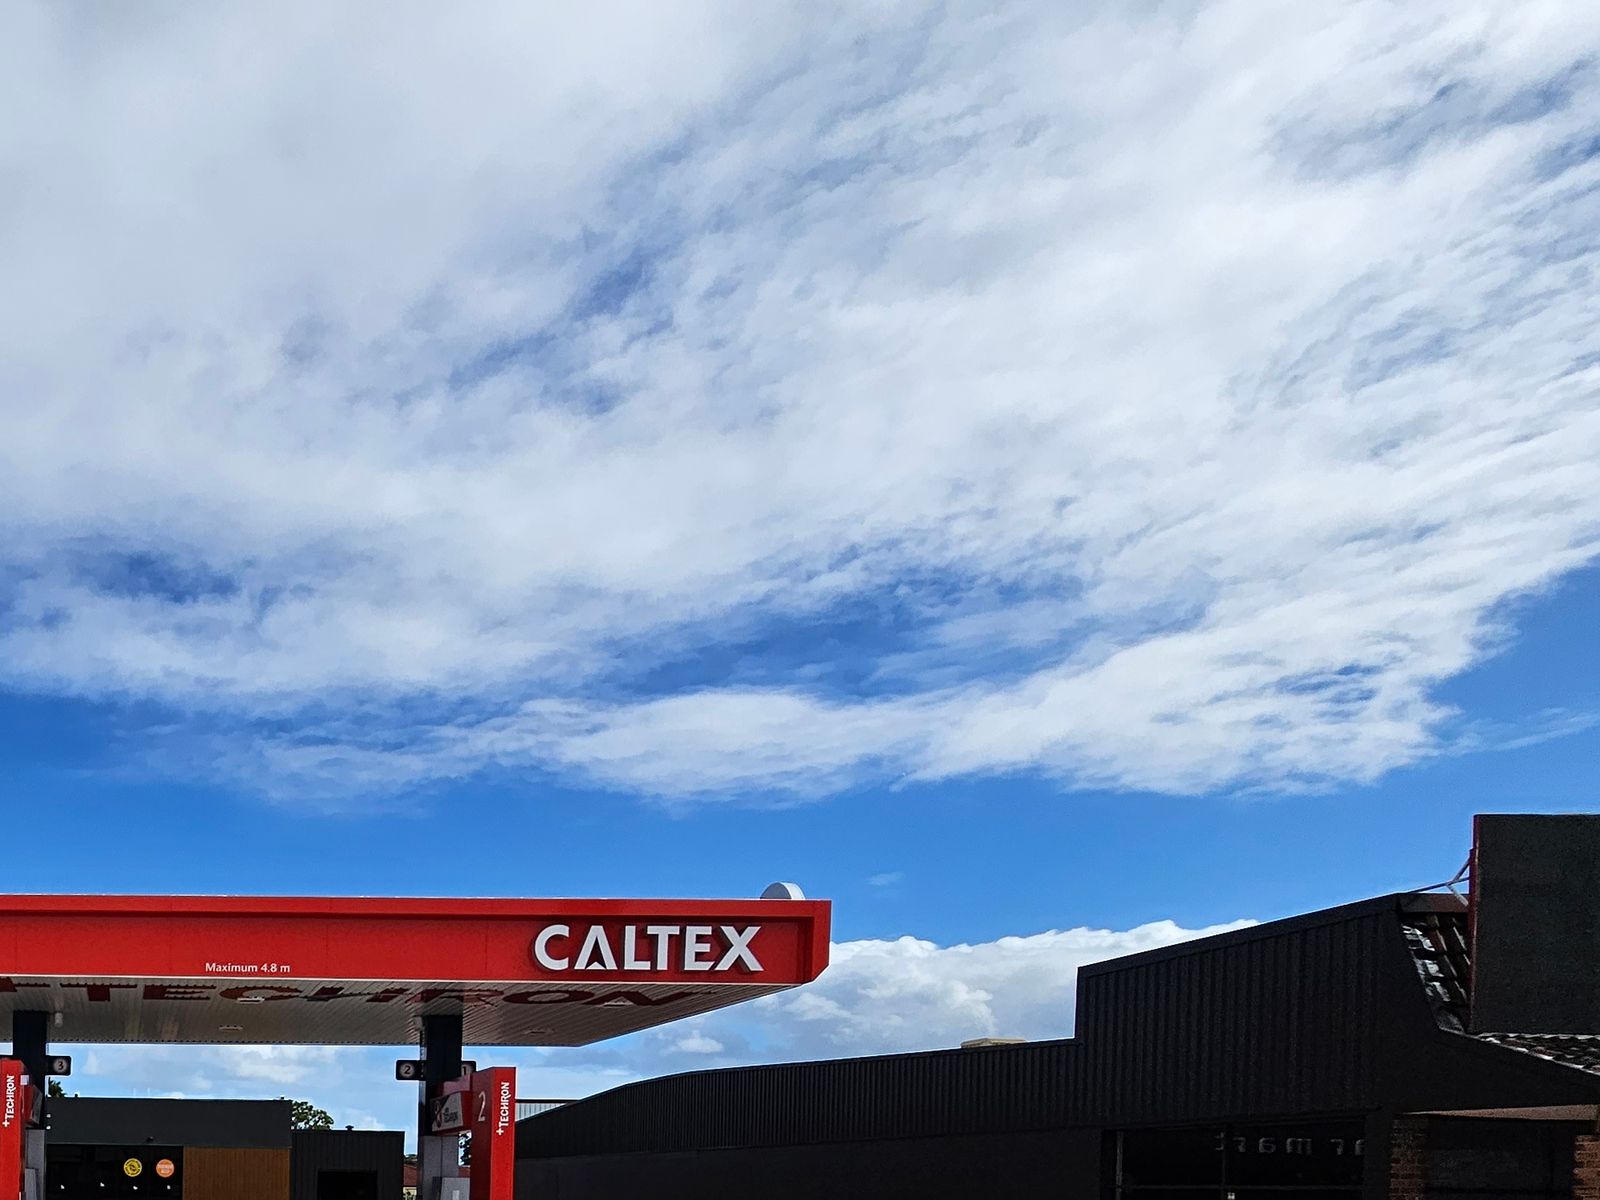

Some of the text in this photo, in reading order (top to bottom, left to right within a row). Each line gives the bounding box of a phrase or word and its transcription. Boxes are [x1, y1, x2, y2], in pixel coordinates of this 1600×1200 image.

[534, 924, 764, 972] CALTEX
[205, 962, 291, 973] Maximum 4.8 m
[57, 1061, 64, 1070] 3
[404, 1065, 411, 1074] 2
[478, 1091, 486, 1122] 2
